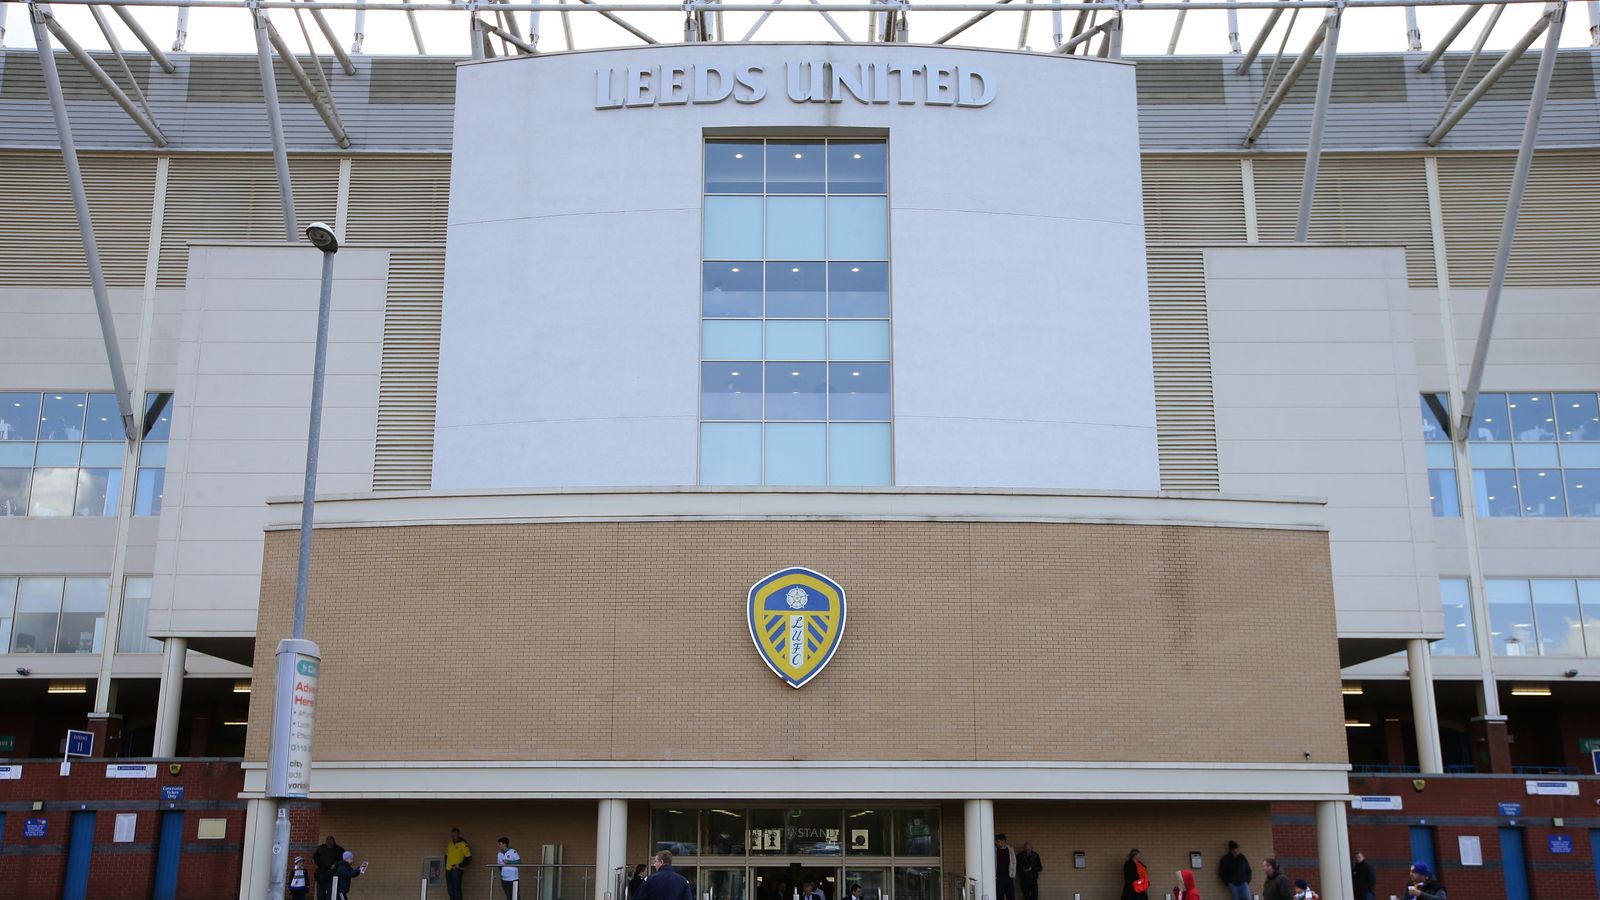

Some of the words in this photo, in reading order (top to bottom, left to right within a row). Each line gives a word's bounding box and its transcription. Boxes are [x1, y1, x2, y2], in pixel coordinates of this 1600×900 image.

[595, 62, 768, 110] LEEDS
[785, 61, 998, 109] UNITED
[289, 760, 303, 768] city
[797, 828, 838, 838] STAND
